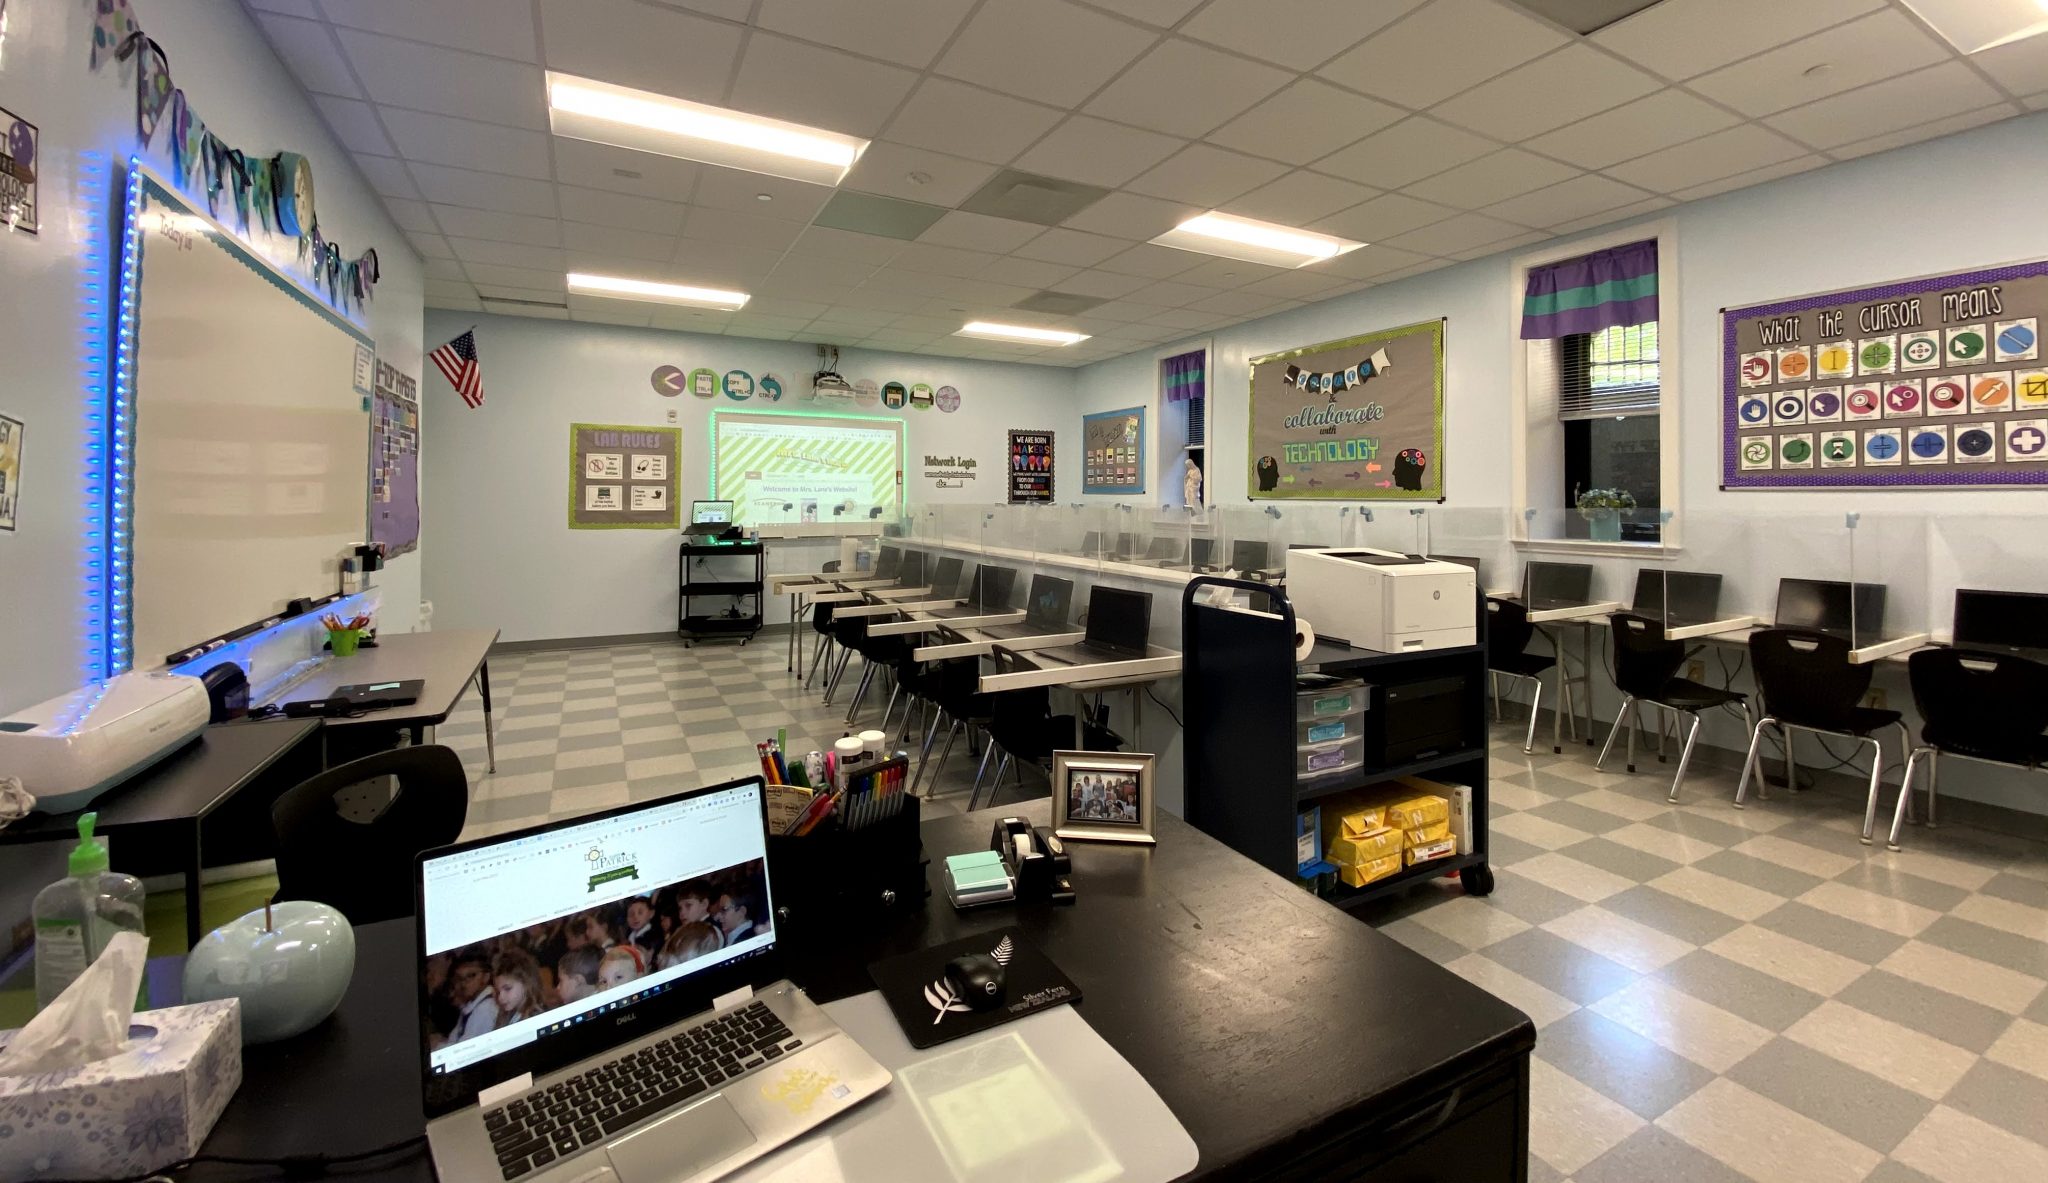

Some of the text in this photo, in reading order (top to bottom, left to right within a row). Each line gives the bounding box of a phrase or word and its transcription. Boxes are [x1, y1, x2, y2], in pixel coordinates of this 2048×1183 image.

[1758, 286, 2003, 345] What the CURSOR means
[1298, 362, 1372, 389] CREATE
[1284, 401, 1384, 429] collaborate
[1320, 425, 1337, 435] with
[593, 432, 660, 449] LAB RULES
[1016, 436, 1024, 444] WE
[1034, 437, 1047, 445] BORN
[1013, 445, 1050, 454] MAKERS
[1282, 437, 1380, 464] TECHNOLOGY
[924, 455, 977, 470] Network Login
[763, 485, 791, 493] Welcome
[800, 485, 813, 493] Mrs.
[600, 852, 638, 868] PATRICK
[1022, 986, 1066, 1001] Silver Fern
[616, 1012, 637, 1026] DELL
